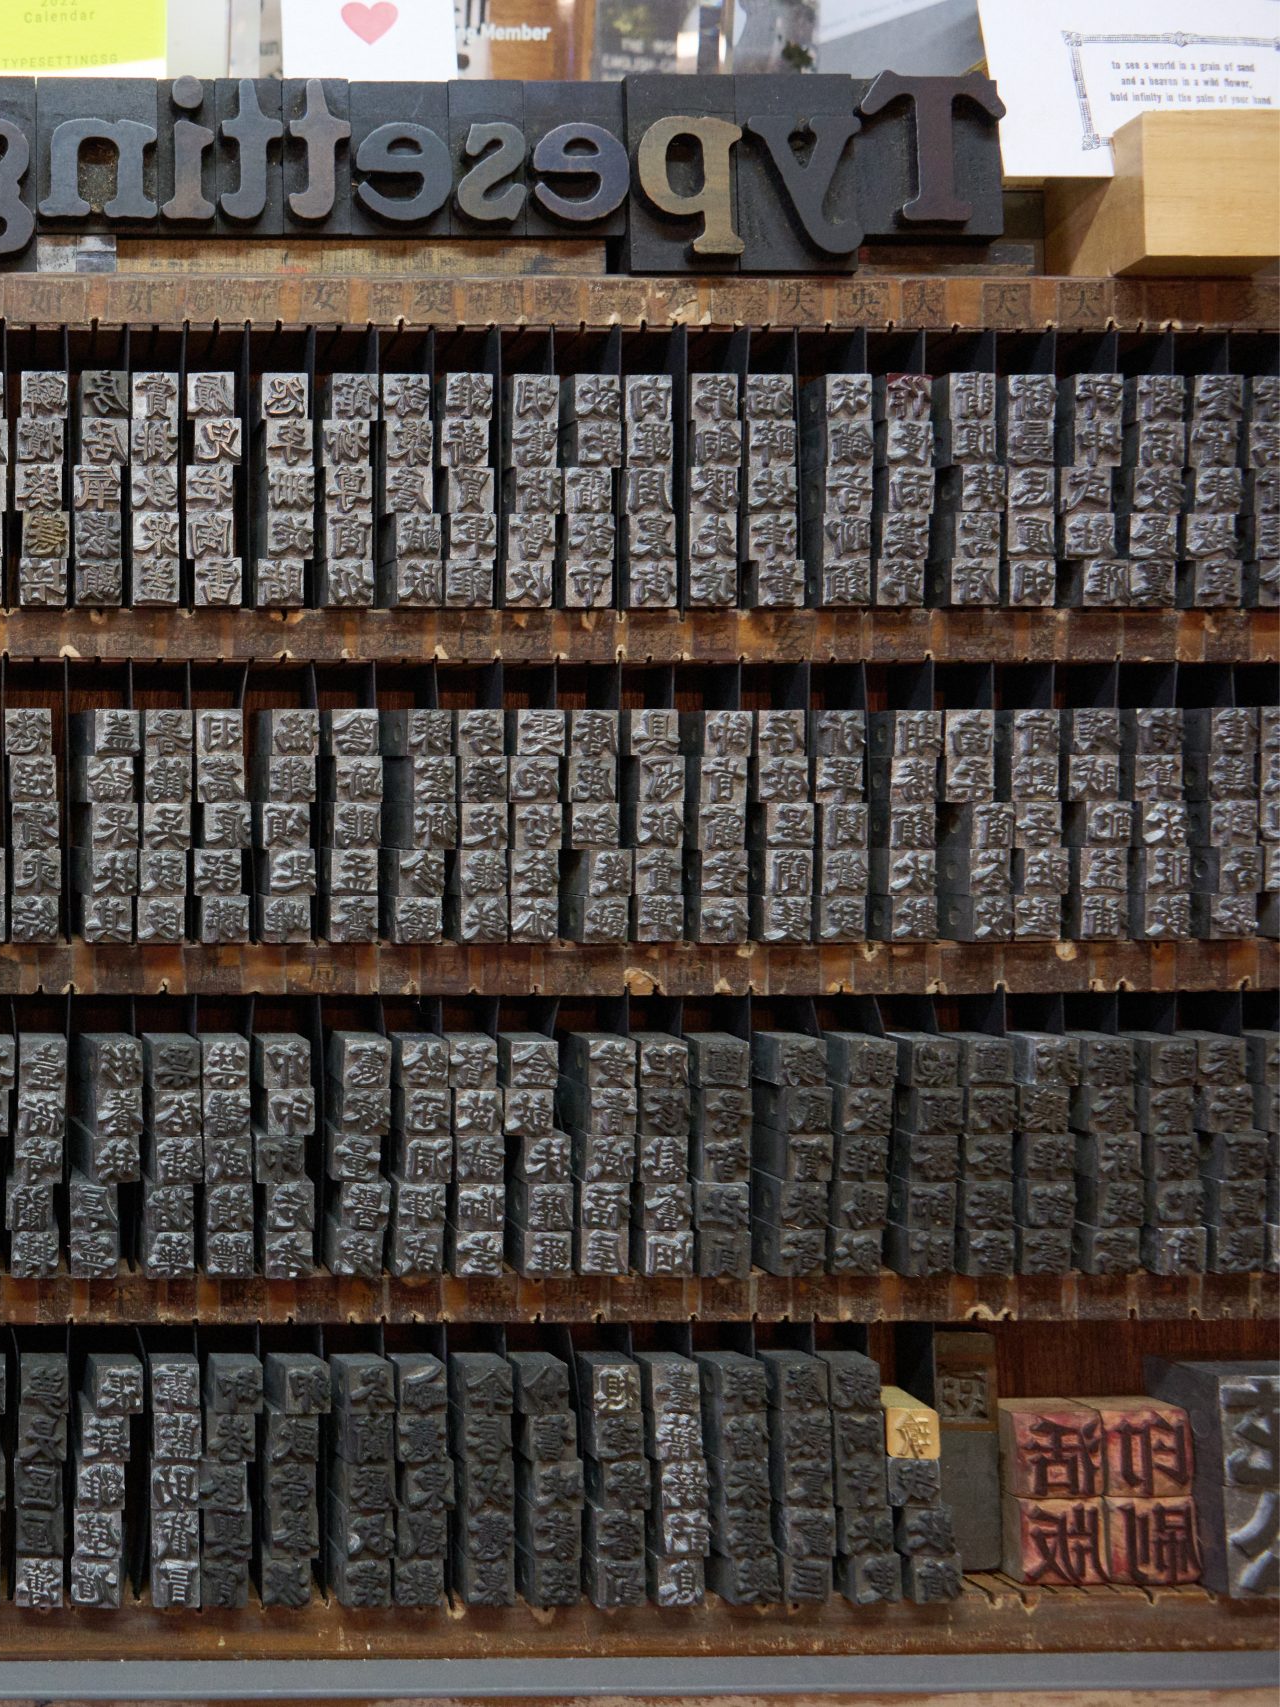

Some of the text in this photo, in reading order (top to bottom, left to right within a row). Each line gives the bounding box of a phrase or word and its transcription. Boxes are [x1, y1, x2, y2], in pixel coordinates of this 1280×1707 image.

[24, 10, 95, 24] Calendar
[480, 23, 552, 42] Member
[1, 53, 119, 68] TYPESETTINGSG
[1112, 61, 1255, 72] to see a world in a grain of sand
[1121, 76, 1136, 86] and
[1140, 78, 1145, 86] a
[1182, 77, 1190, 86] in
[1110, 92, 1128, 102] hold
[1132, 92, 1162, 104] infinity
[1166, 94, 1174, 102] in
[1178, 93, 1191, 102] the
[1218, 94, 1227, 103] of
[1231, 95, 1249, 105] your
